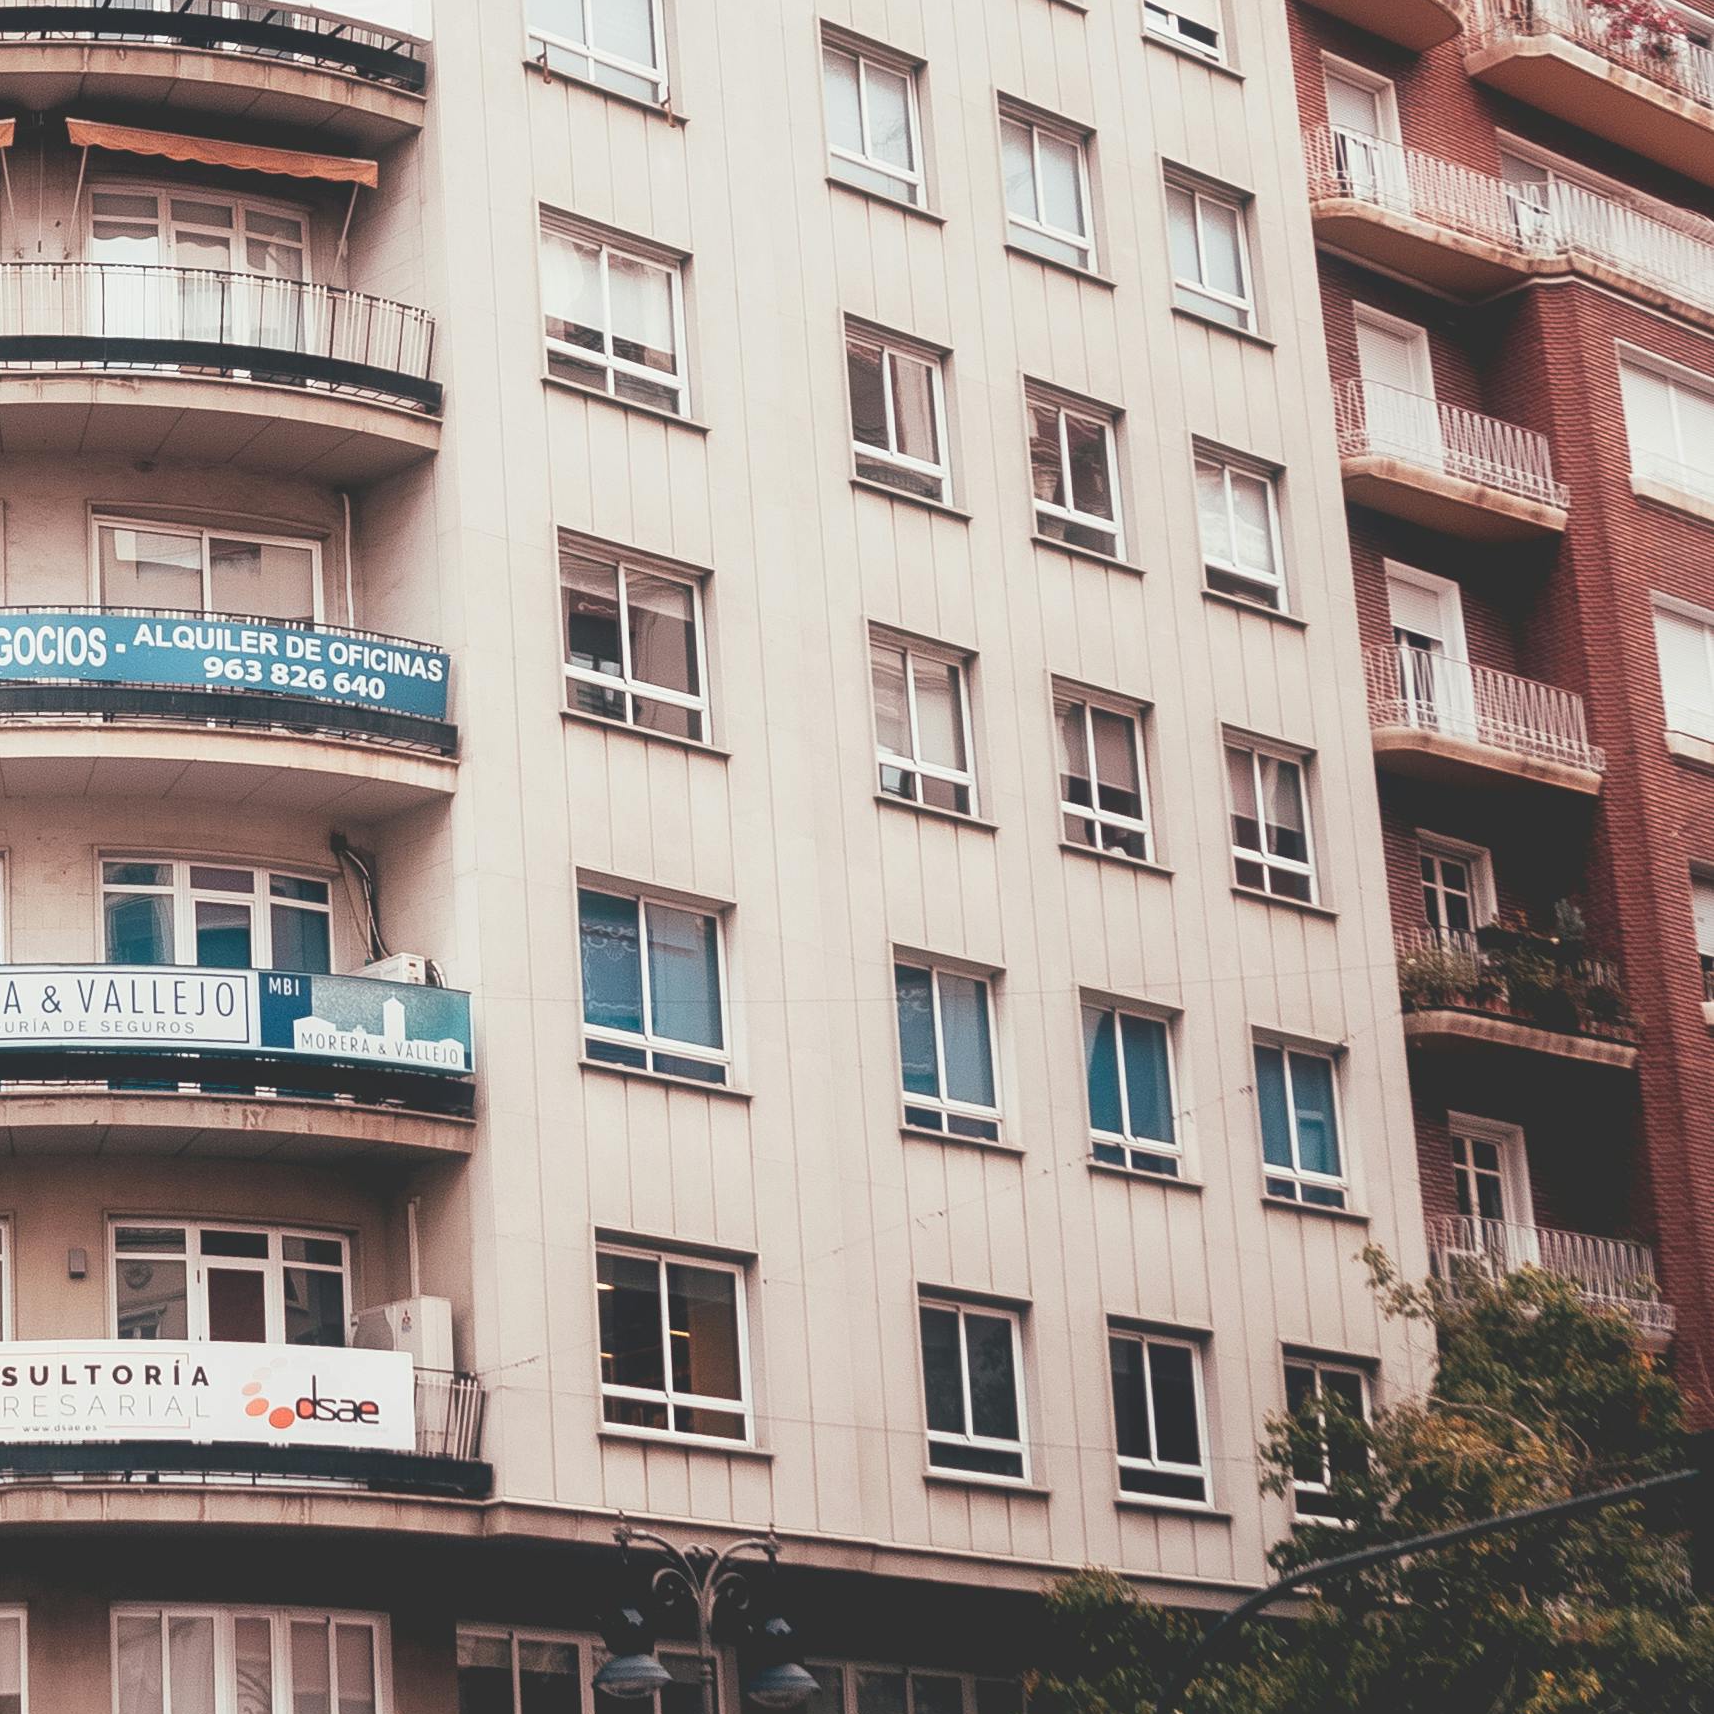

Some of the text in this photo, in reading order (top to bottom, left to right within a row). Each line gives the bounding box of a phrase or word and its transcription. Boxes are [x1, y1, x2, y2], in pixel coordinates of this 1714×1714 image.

[132, 623, 279, 656] ALQUILER
[285, 635, 323, 662] DE
[327, 641, 444, 683] OFICINAS
[202, 656, 386, 700] 963 826 640
[41, 984, 63, 1015] &
[76, 978, 235, 1018] VALLEJO
[267, 976, 301, 997] MBI
[63, 1019, 87, 1034] DE
[100, 1019, 196, 1035] SEGUROS
[300, 1032, 459, 1065] MORERA & VALLEJO
[295, 1374, 380, 1425] dsae
[22, 1422, 98, 1434] www.dsae.es
